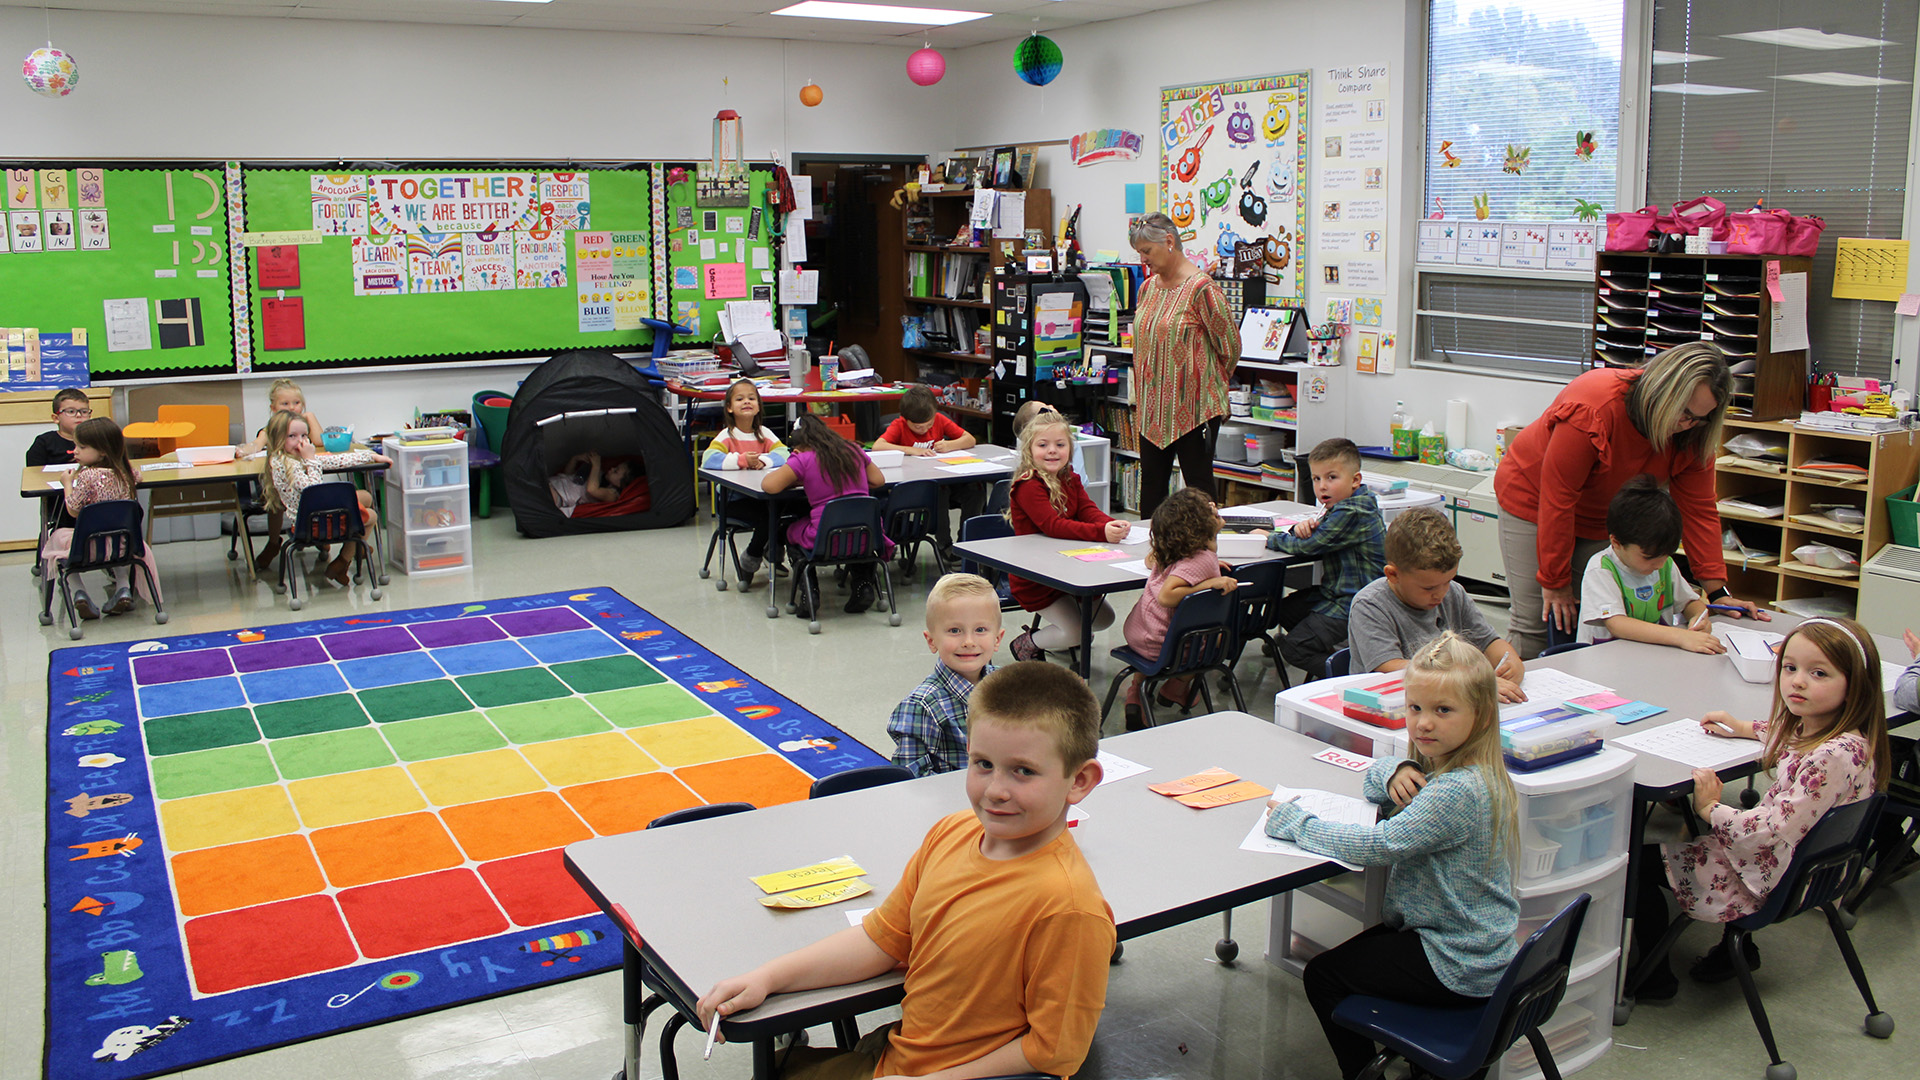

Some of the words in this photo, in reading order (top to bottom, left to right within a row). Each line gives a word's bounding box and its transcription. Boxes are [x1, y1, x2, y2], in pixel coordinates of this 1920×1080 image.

[1328, 68, 1353, 80] Think
[1358, 65, 1386, 79] Share
[1338, 83, 1372, 94] Compare
[1163, 92, 1222, 148] Colors
[14, 171, 28, 182] Uu
[47, 172, 60, 182] Cc
[82, 170, 99, 181] Oo
[317, 184, 361, 195] APOLOGIZE
[381, 176, 524, 200] TOGETHER
[545, 184, 584, 197] RESPECT
[318, 203, 362, 219] FORGIVE
[405, 204, 427, 221] WE
[432, 203, 456, 221] ARE
[463, 202, 510, 220] BETTER
[437, 222, 482, 231] because
[249, 236, 277, 245] Buckeye
[279, 234, 300, 244] School
[301, 234, 319, 242] Rules
[583, 235, 604, 245] RED
[612, 234, 646, 243] GREEN
[1467, 229, 1473, 239] 2
[1512, 231, 1518, 241] 3
[1558, 232, 1565, 241] 4
[1731, 224, 1750, 245] R
[362, 246, 398, 262] LEARN
[466, 243, 510, 256] CELEBRATE
[520, 242, 561, 254] ENCOURAGE
[420, 260, 452, 276] TEAM
[1516, 258, 1531, 266] three
[1565, 260, 1577, 268] four
[471, 263, 507, 274] SUCCESS
[368, 277, 395, 286] MISTAKES
[591, 273, 607, 281] How
[594, 280, 632, 289] FEELING?
[583, 306, 611, 316] BLUE
[615, 304, 648, 314] YELLOW
[512, 598, 556, 608] Mm
[295, 623, 339, 633] Kk
[643, 640, 677, 651] Pp
[723, 690, 759, 704] Rr
[767, 719, 801, 737] Ss
[73, 738, 115, 753] Ff
[819, 752, 864, 770] Tt
[1319, 751, 1368, 769] Red
[79, 769, 119, 791] Ee
[1201, 791, 1242, 804] Piper
[81, 813, 127, 837] Dd
[85, 860, 131, 884] Cc
[787, 866, 843, 879] Teresa
[86, 919, 142, 950] Bb
[440, 950, 515, 983] Yy
[86, 987, 154, 1021] Aa
